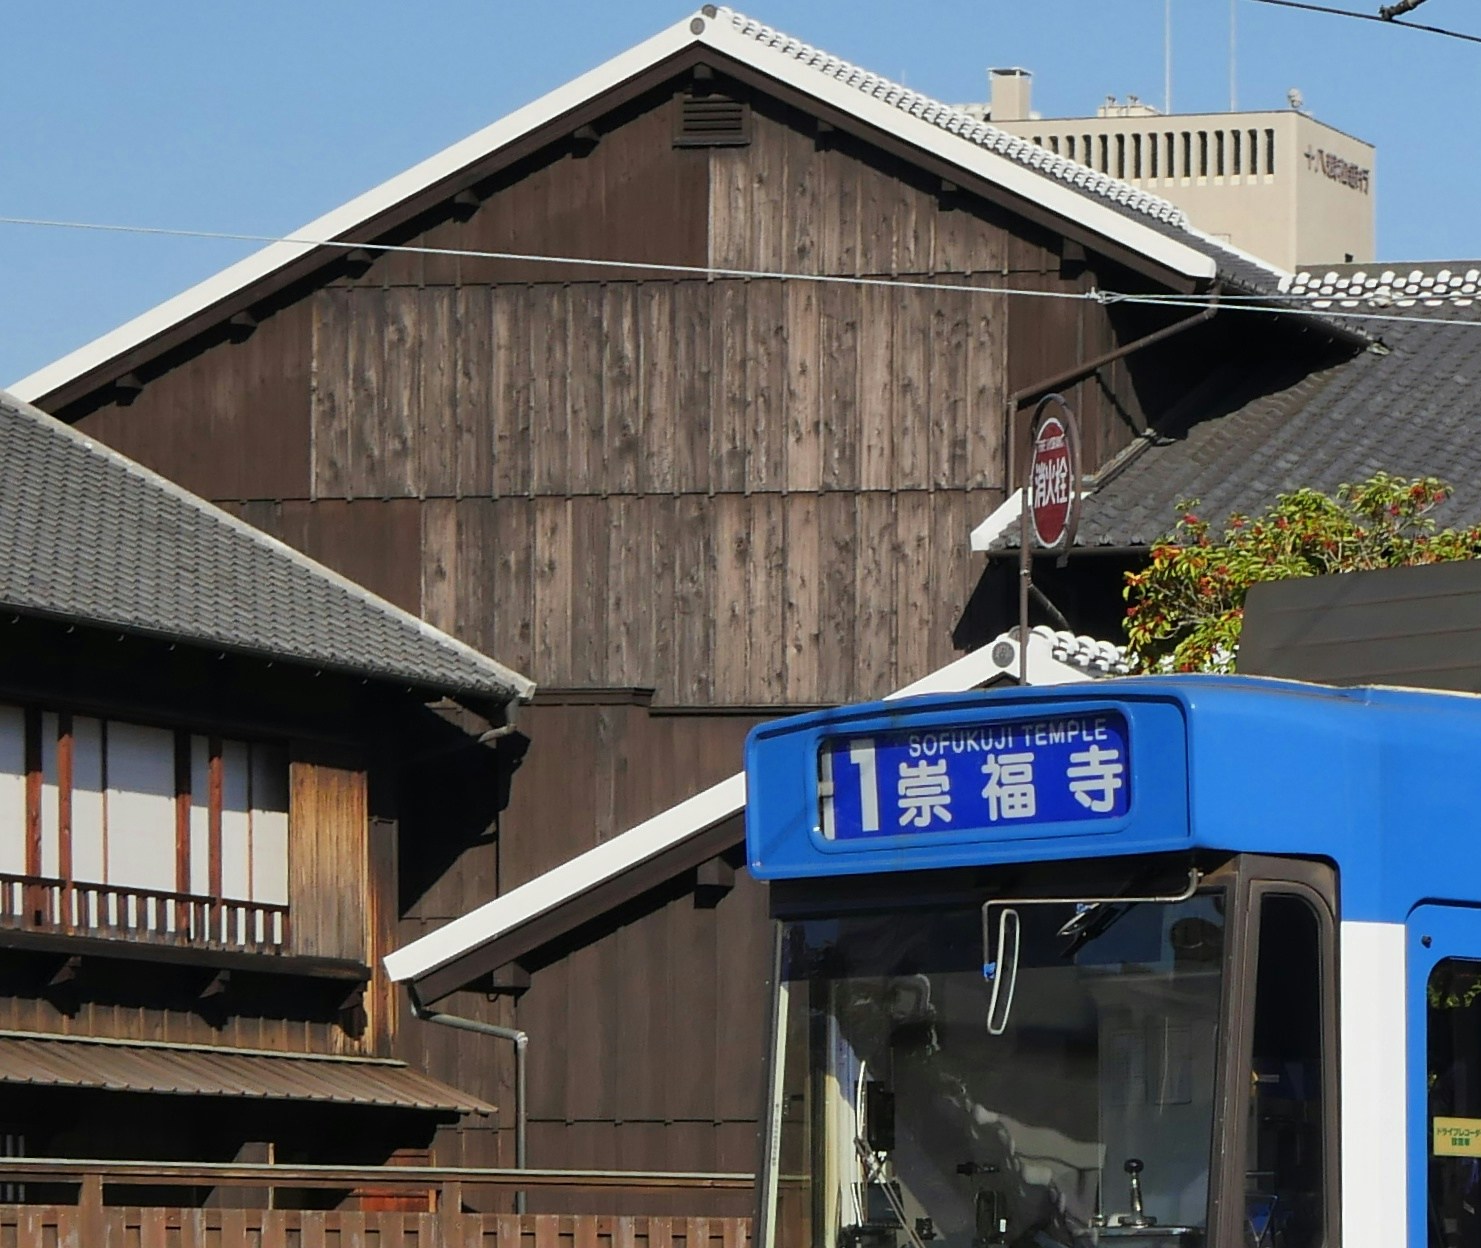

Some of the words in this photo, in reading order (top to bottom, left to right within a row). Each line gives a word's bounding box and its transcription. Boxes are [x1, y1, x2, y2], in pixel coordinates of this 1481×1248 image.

[908, 727, 1013, 758] SOFUKUJI
[1021, 718, 1108, 748] TEMPLE
[897, 744, 1124, 828] 崇福寺
